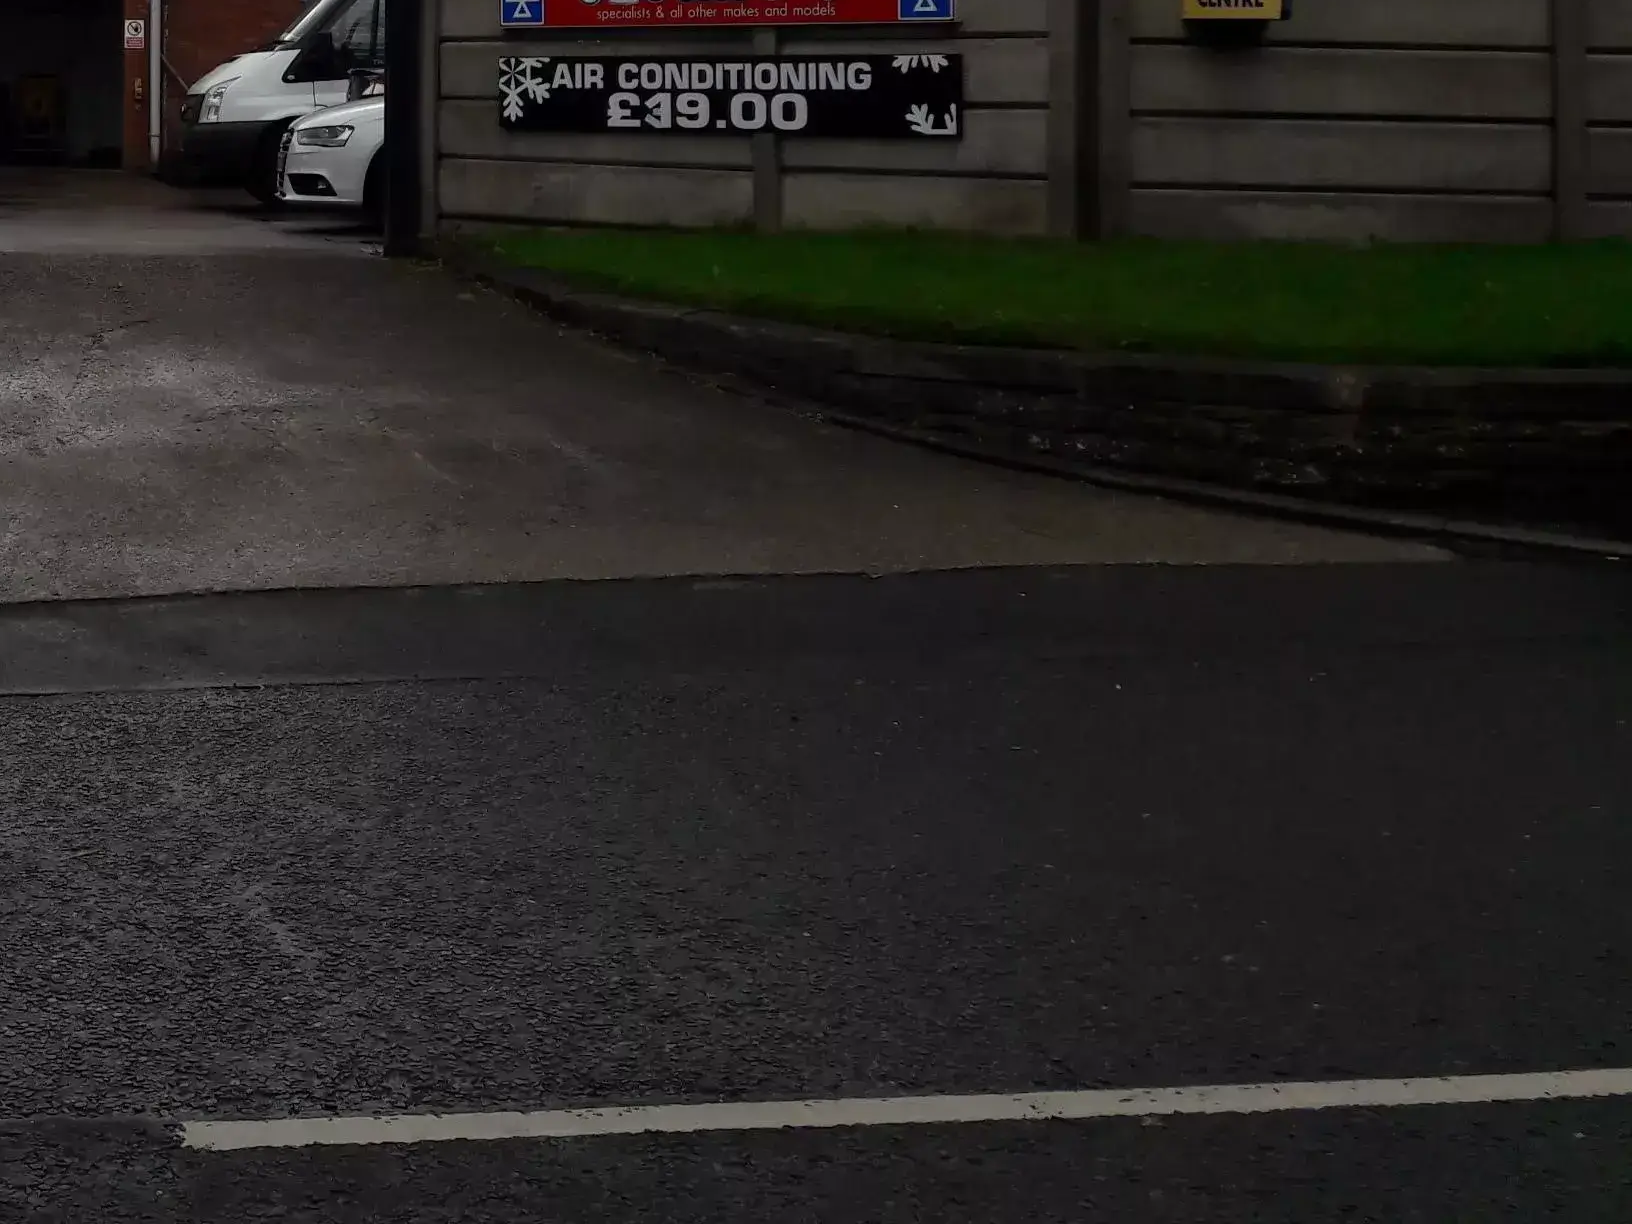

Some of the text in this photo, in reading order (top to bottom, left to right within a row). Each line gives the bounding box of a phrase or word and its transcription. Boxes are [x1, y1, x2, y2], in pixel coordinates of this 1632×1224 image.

[596, 0, 837, 22] specialists & all other makes and models
[552, 61, 873, 91] AIR CONDITIONING
